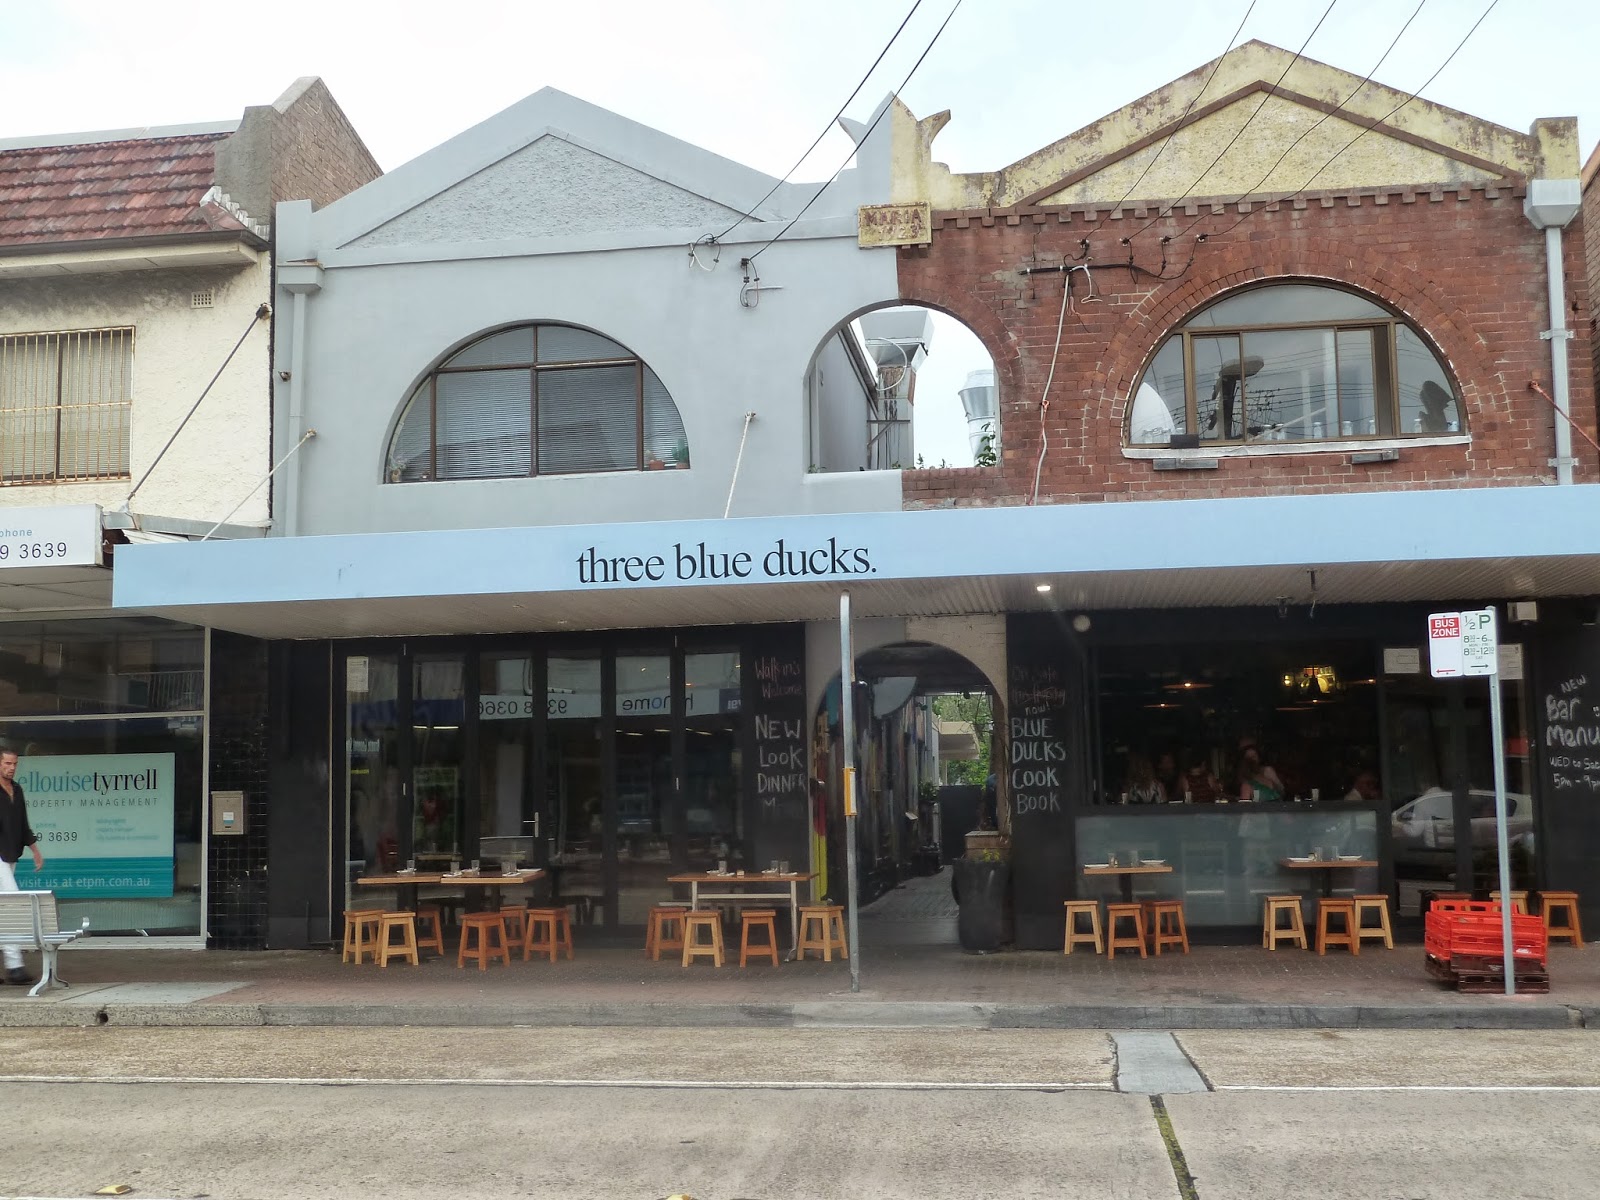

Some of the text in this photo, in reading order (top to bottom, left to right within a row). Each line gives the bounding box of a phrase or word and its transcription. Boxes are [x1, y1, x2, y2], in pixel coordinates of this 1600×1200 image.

[19, 541, 67, 559] 3639
[575, 536, 878, 584] three blue ducks.
[1434, 619, 1455, 628] BUS
[1479, 614, 1491, 630] P
[1432, 628, 1459, 637] ZONE
[1560, 675, 1587, 693] NEW
[1546, 694, 1581, 722] Bar
[755, 714, 801, 740] NEW
[1011, 717, 1054, 738] BLUE
[1546, 724, 1600, 747] Menu
[1012, 741, 1067, 764] DUCKS
[1549, 755, 1570, 767] WED
[24, 797, 158, 808] ROPERTY MANAGEMENT
[48, 831, 78, 842] 3639
[18, 876, 151, 889] visit us at etpm.com.au
